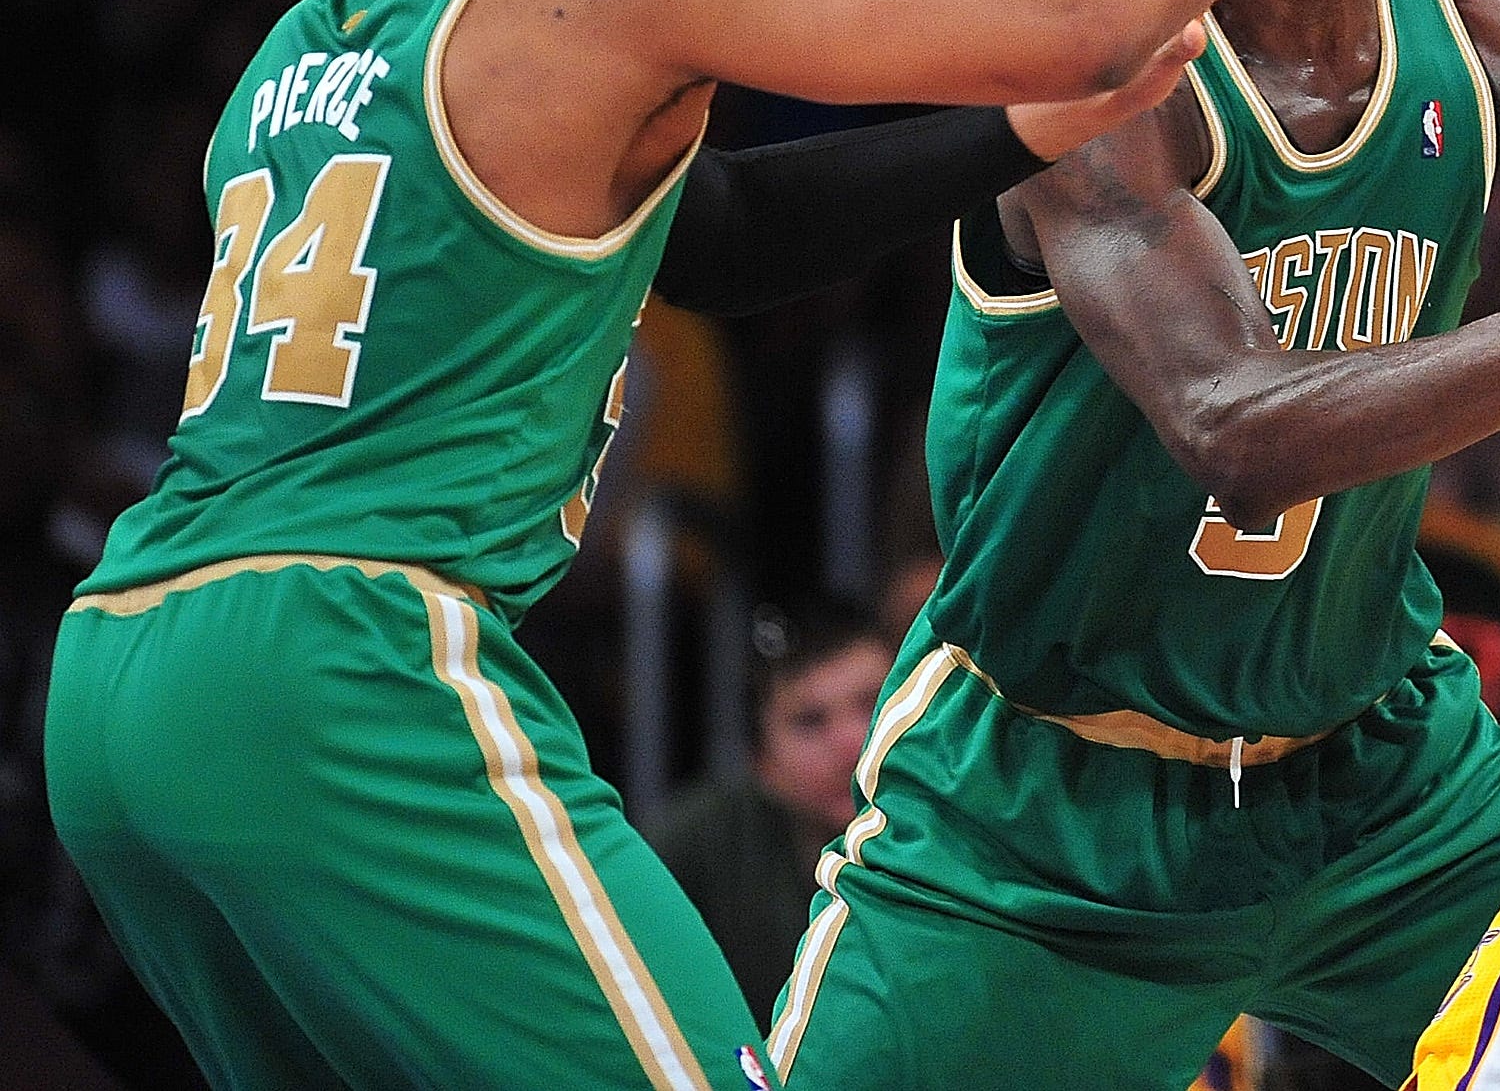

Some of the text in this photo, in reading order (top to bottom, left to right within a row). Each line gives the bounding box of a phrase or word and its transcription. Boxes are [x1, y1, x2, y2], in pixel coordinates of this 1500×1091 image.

[248, 48, 391, 153] PIERCE
[178, 153, 392, 423] 34
[1241, 226, 1439, 351] STON
